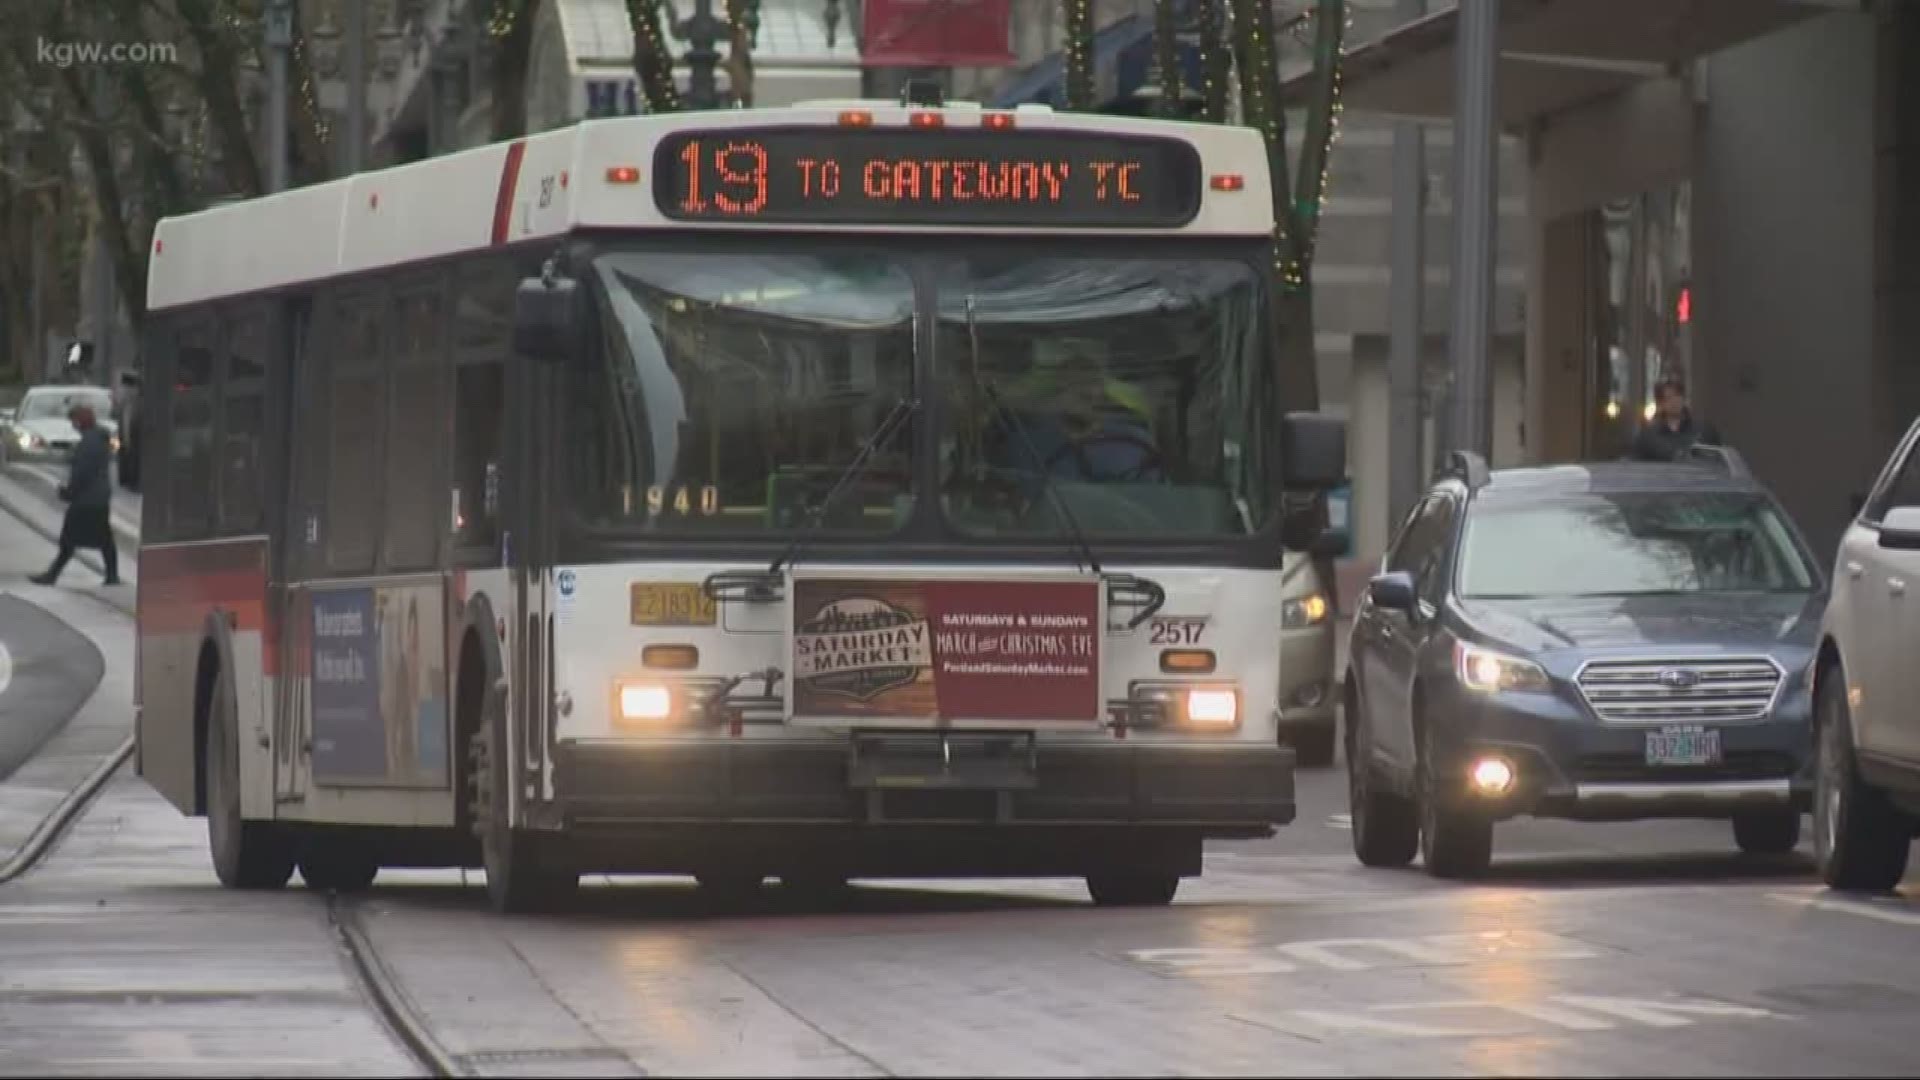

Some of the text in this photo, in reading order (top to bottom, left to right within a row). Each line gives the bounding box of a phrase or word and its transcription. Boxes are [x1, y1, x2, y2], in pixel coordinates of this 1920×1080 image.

[681, 140, 1142, 214] 19 TO GATEWAY TC
[943, 614, 1014, 626] SATURDAYS
[1031, 615, 1088, 627] SUNDAYS
[797, 625, 923, 655] SATURDAY
[936, 632, 976, 655] MARCH
[1000, 633, 1066, 656] CHRISTMAS
[1072, 634, 1093, 656] EVE
[1151, 622, 1205, 645] 2517
[814, 646, 910, 671] MARKET
